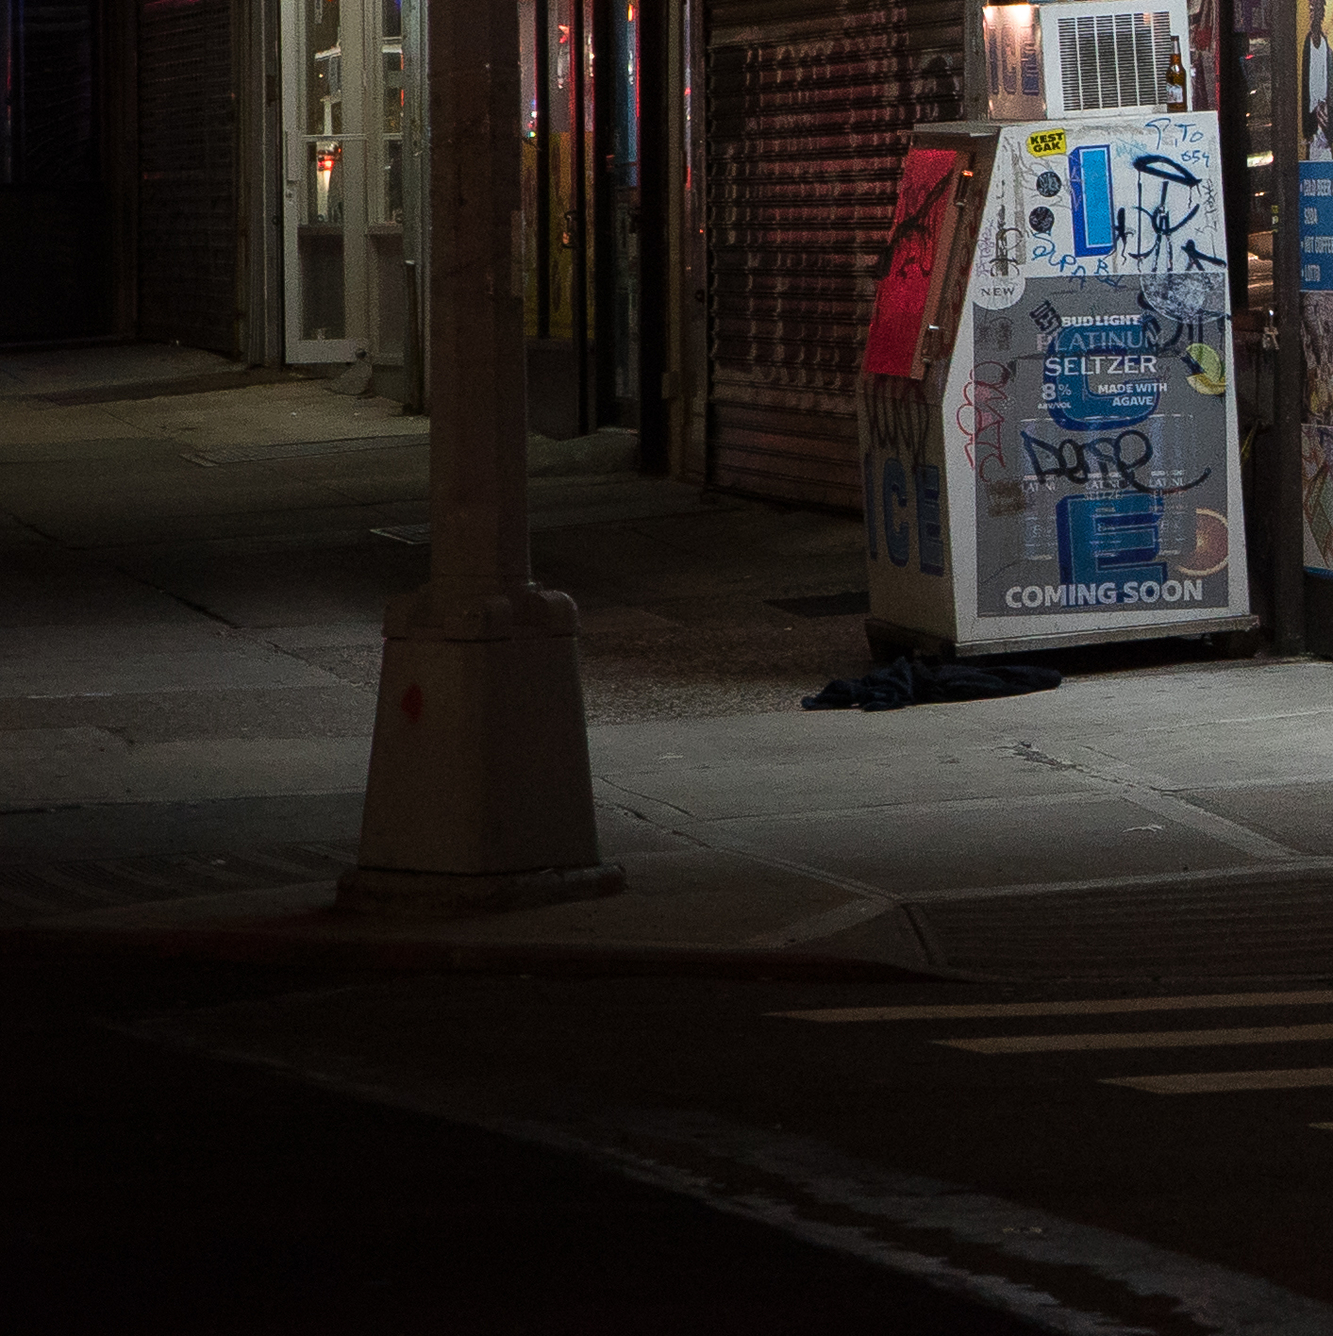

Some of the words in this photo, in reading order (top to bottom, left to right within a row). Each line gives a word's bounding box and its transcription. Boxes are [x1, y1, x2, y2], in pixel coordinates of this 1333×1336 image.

[1030, 132, 1065, 145] KEST
[1032, 141, 1062, 154] GAK
[980, 286, 1016, 298] NEW
[1061, 315, 1093, 328] BUD
[1094, 313, 1142, 327] LIGHT
[1036, 330, 1160, 354] PLATINUM
[1044, 354, 1158, 377] SELTZER
[1098, 382, 1134, 395] MADE
[1134, 381, 1168, 394] WITH
[1111, 395, 1154, 407] AGAVE
[1004, 581, 1117, 609] COMING
[1122, 579, 1204, 604] SOON
